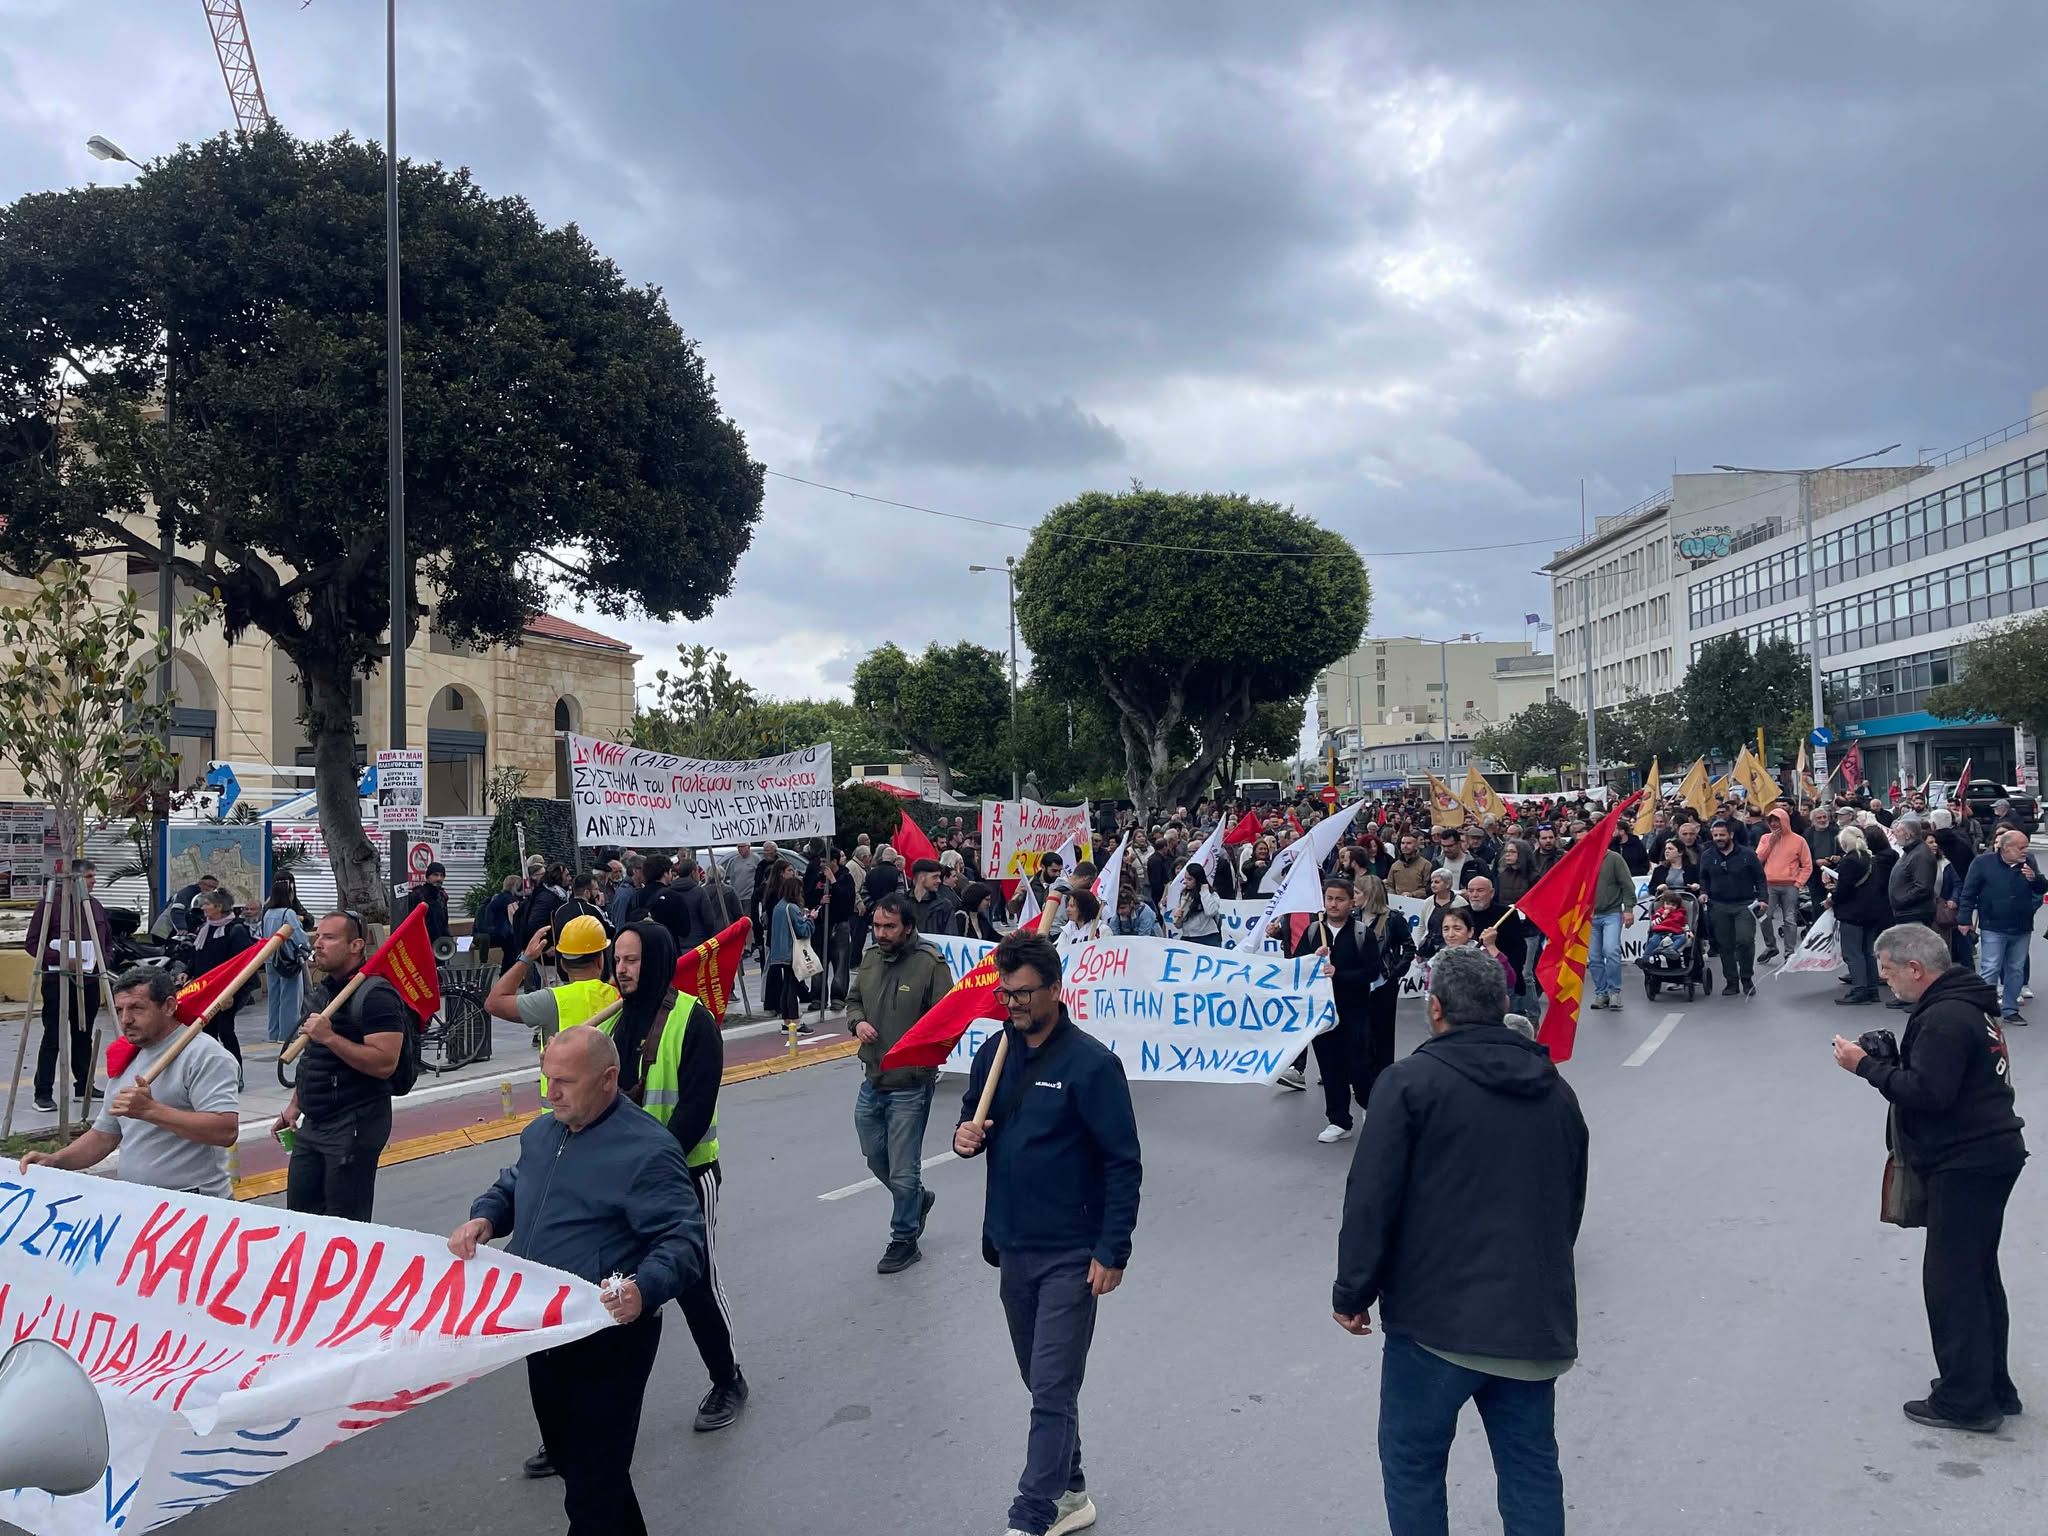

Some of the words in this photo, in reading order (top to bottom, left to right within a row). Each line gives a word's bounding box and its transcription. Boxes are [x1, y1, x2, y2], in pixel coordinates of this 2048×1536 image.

[593, 741, 630, 766] ΜΑΗ
[630, 752, 679, 770] ΚΑΤΩ
[680, 760, 699, 772] Η
[574, 767, 639, 792] ΣΥΣΤΗΜΑ
[736, 779, 755, 791] της
[1173, 992, 1336, 1033] ΕΡΓΟΔΟΣΙΑ
[19, 1195, 122, 1268] ΣΤΗΝ
